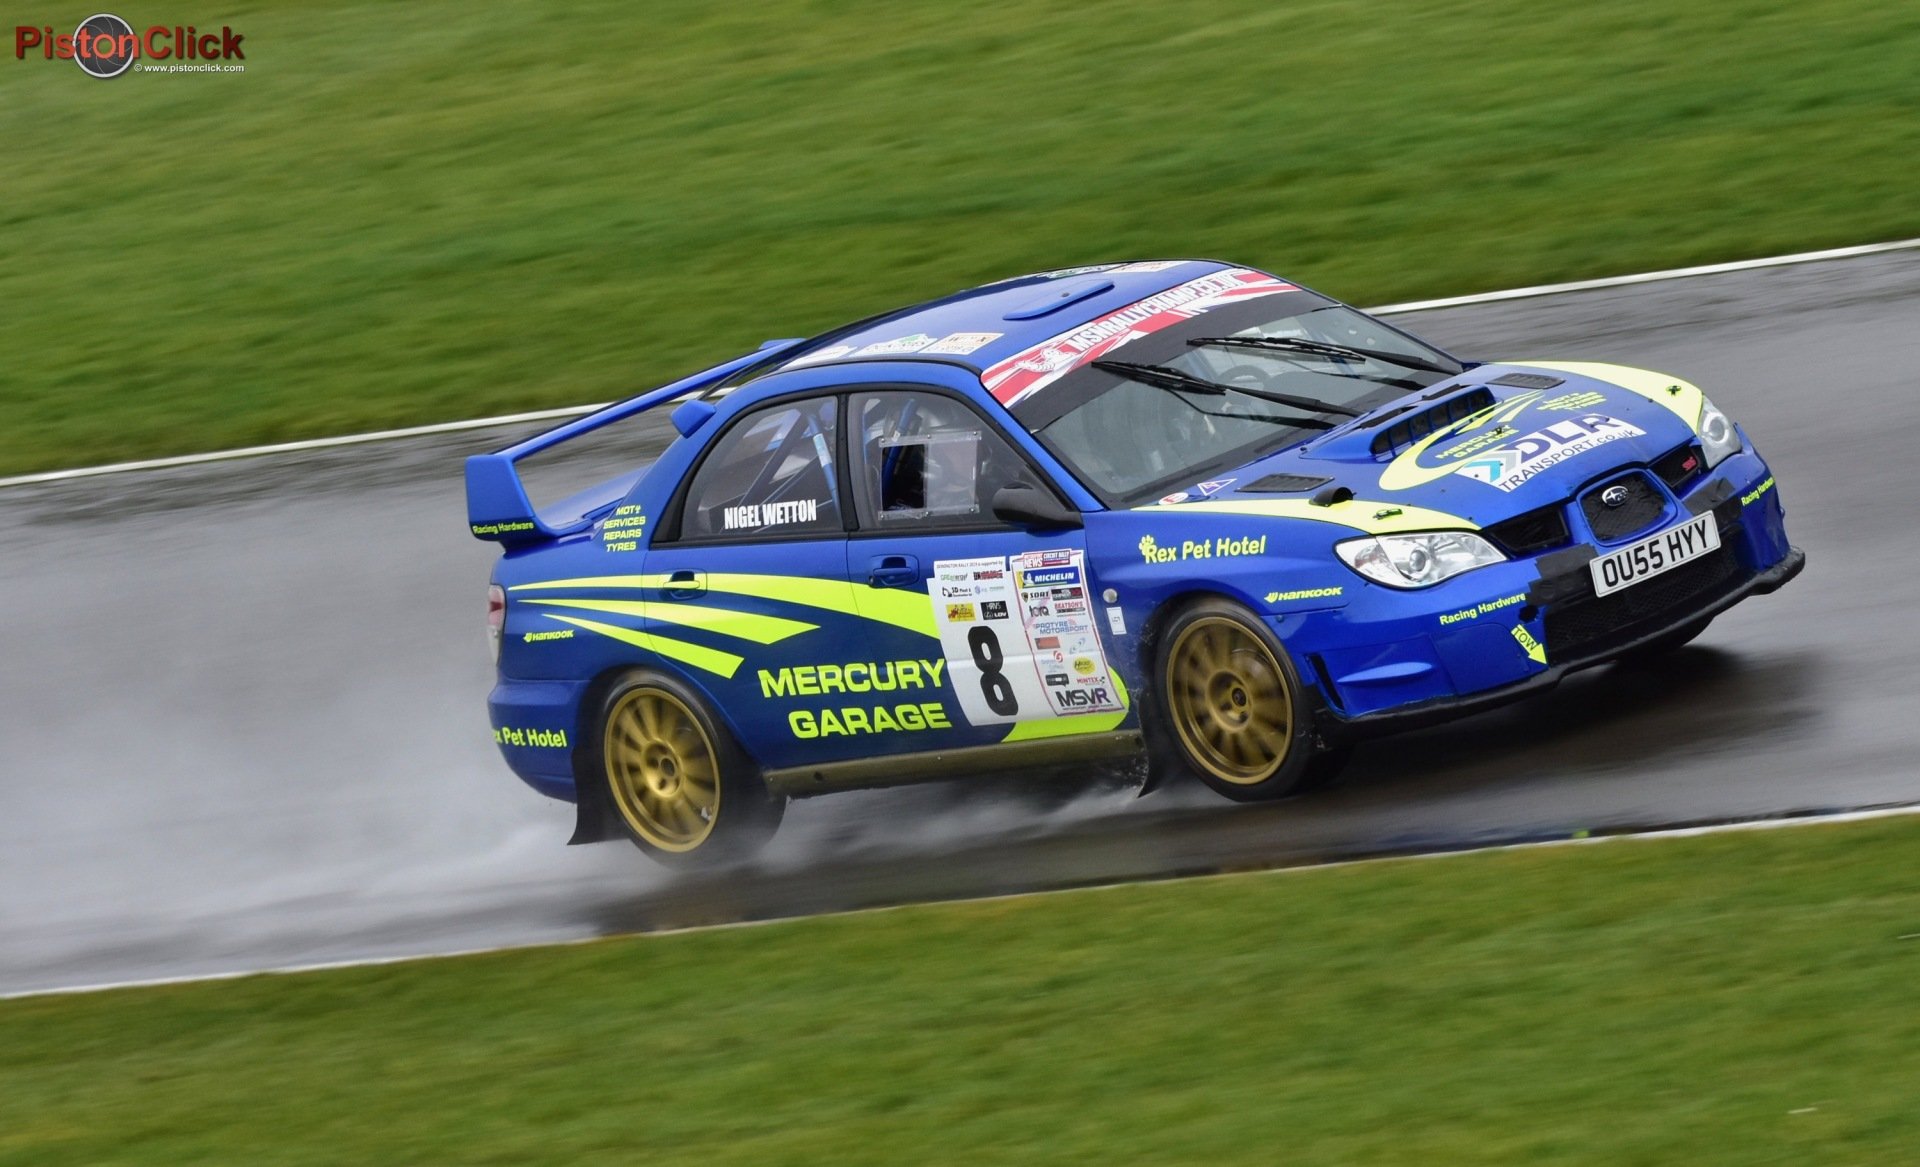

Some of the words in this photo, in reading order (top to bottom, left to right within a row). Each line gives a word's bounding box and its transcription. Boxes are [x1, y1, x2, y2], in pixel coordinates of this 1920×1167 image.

[1494, 414, 1622, 464] DLR
[603, 515, 646, 529] SERVICES
[724, 504, 761, 530] NIGEL
[762, 499, 817, 526] WETTON
[472, 525, 499, 535] Racing
[498, 521, 534, 532] Hardware
[603, 528, 642, 541] REPAIRS
[606, 541, 637, 553] TYRES
[1144, 544, 1177, 564] Rex
[1182, 539, 1211, 560] Pet
[1216, 534, 1267, 557] Hotel
[1602, 539, 1664, 588] OU55
[1666, 519, 1707, 562] HYY
[1034, 572, 1075, 583] MICHELIN
[1439, 608, 1478, 625] Racing
[1478, 593, 1526, 614] Hardware
[1040, 625, 1088, 634] MOTORSPORT
[1512, 626, 1538, 652] TOW
[757, 658, 945, 698] MERCURY
[968, 626, 1019, 716] 8
[1055, 687, 1111, 707] MSVR
[788, 702, 953, 739] GARAGE
[502, 726, 527, 746] Pet
[526, 727, 568, 748] Hotel
